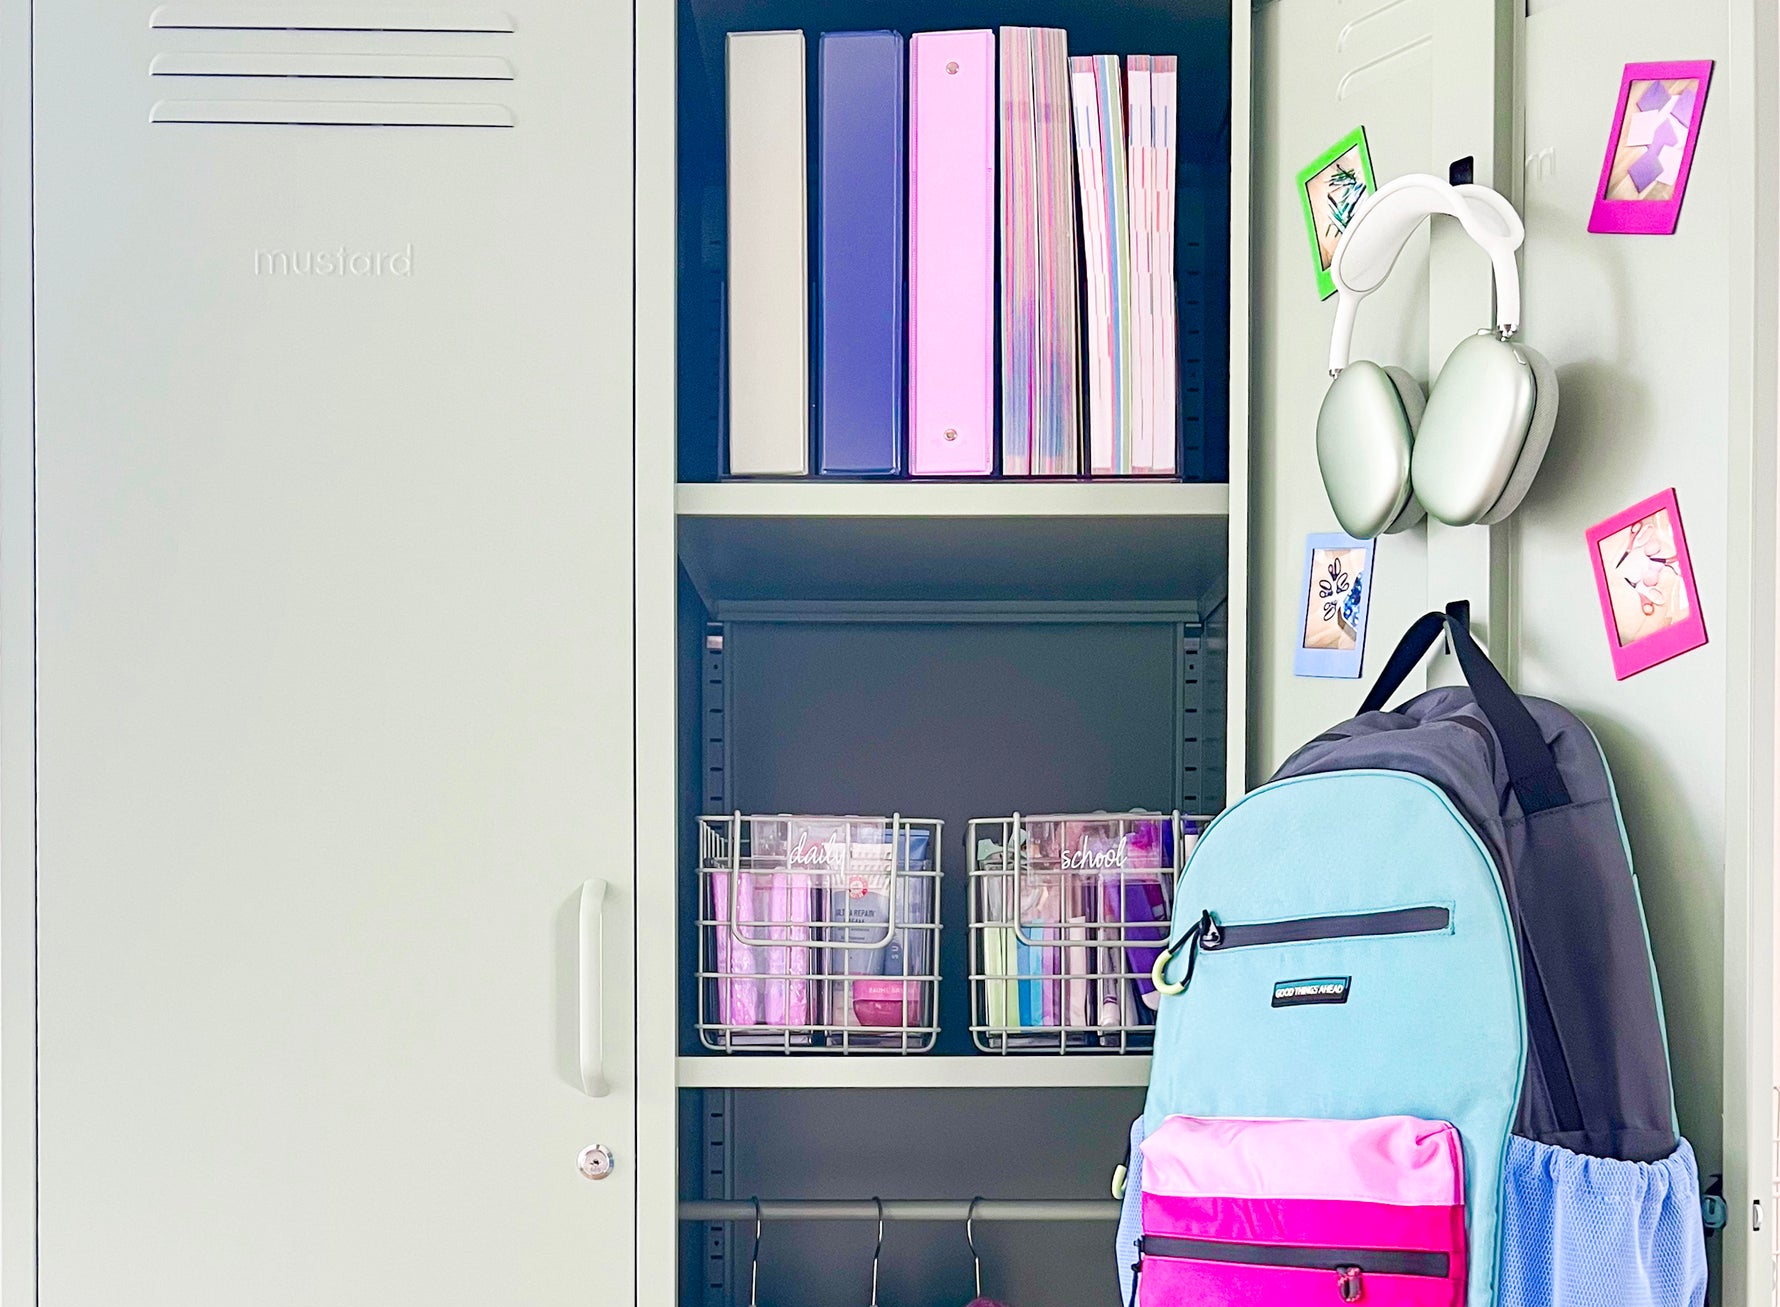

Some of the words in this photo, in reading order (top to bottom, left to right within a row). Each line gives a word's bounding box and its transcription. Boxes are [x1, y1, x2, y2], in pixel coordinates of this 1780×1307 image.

[253, 243, 413, 276] mustard
[789, 831, 846, 877] daily
[1060, 835, 1128, 870] school
[1275, 988, 1294, 998] GOOD
[1295, 986, 1318, 995] THINGS
[1318, 984, 1343, 993] AHEAD
